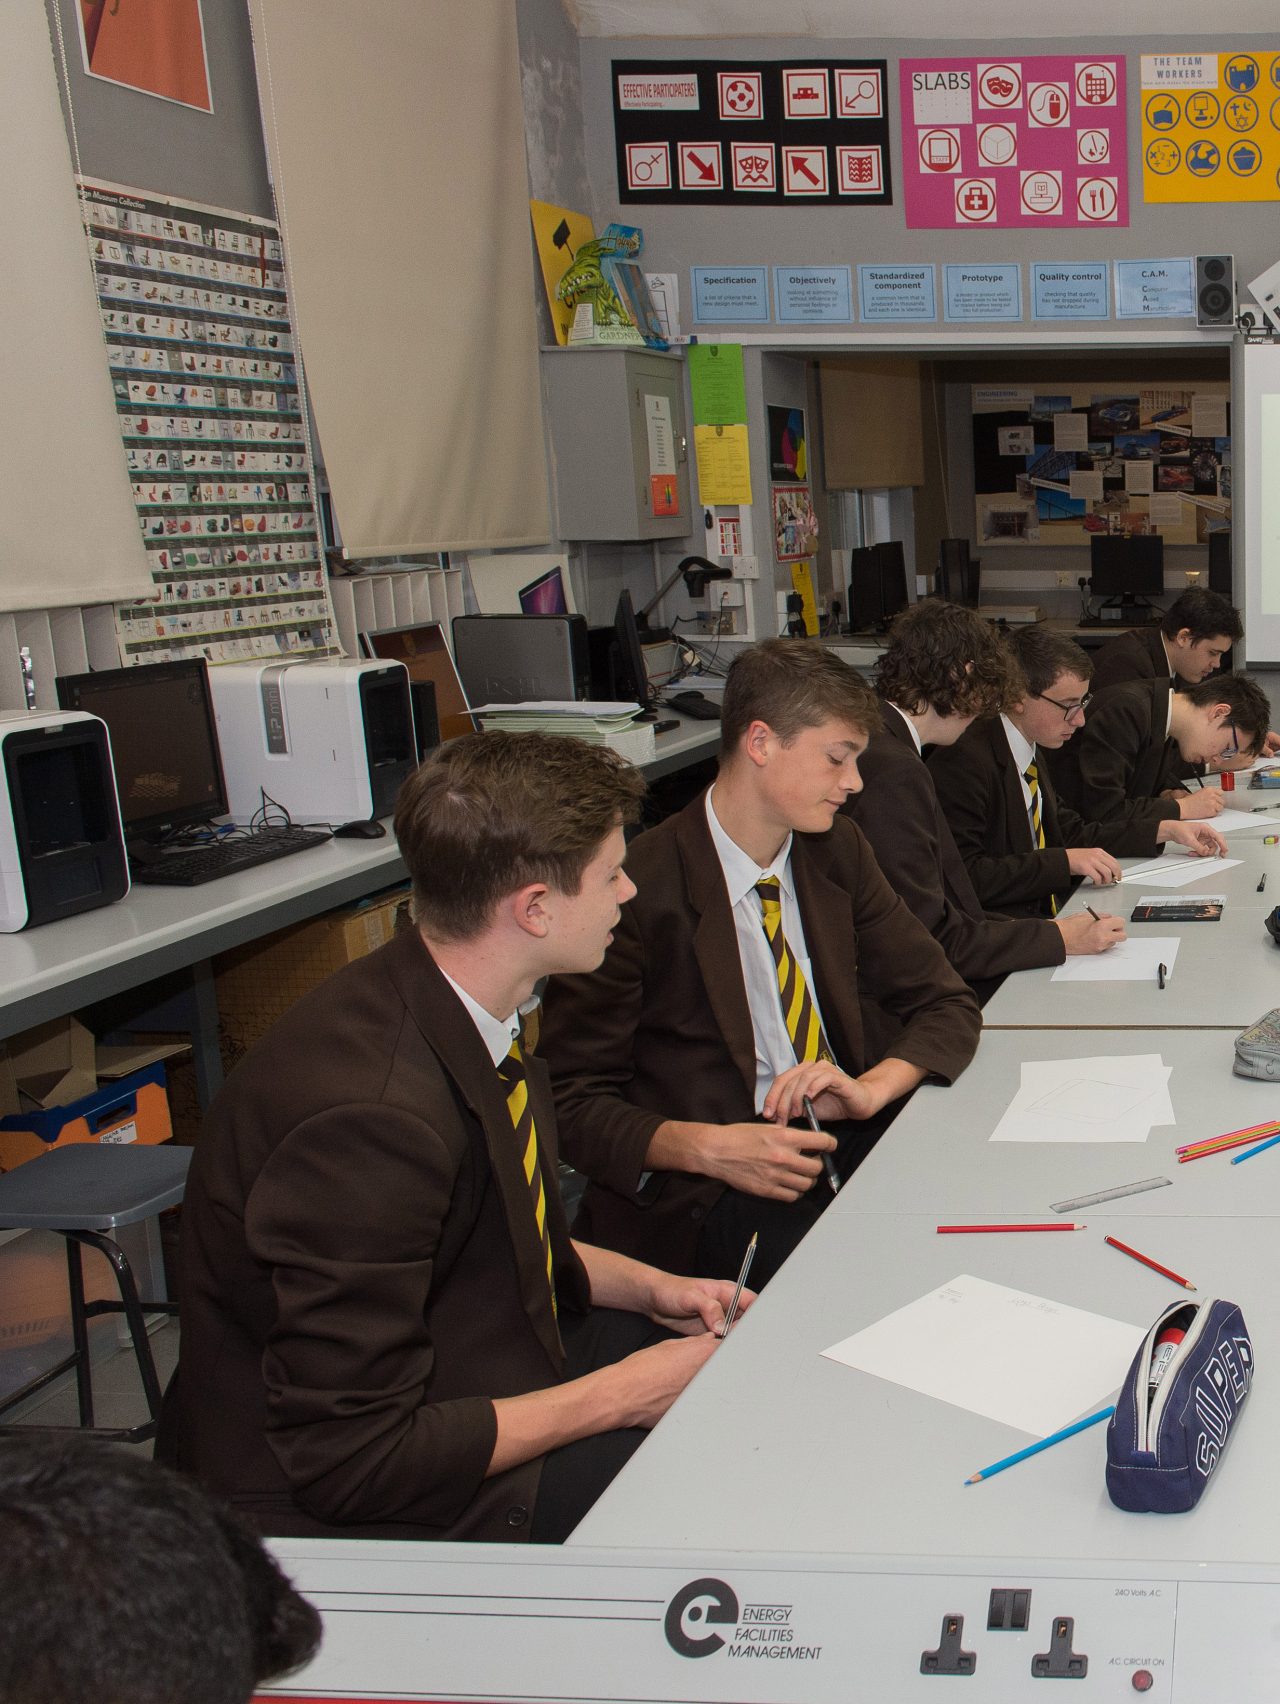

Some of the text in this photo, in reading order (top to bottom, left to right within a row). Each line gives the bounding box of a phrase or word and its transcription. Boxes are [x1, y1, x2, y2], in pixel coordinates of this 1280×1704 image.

[1154, 57, 1202, 66] THE TEAM
[1157, 70, 1202, 78] WORKERS
[914, 73, 970, 90] SLABS
[623, 84, 652, 98] EFFECTIVE
[704, 277, 756, 285] Specification
[790, 276, 836, 285] Objectively
[962, 274, 1003, 283] Prototype
[1040, 273, 1069, 282] Quality
[743, 1608, 792, 1621] ENERGY
[734, 1628, 794, 1642] FACILITIES
[727, 1645, 822, 1660] MANAGEMENT
